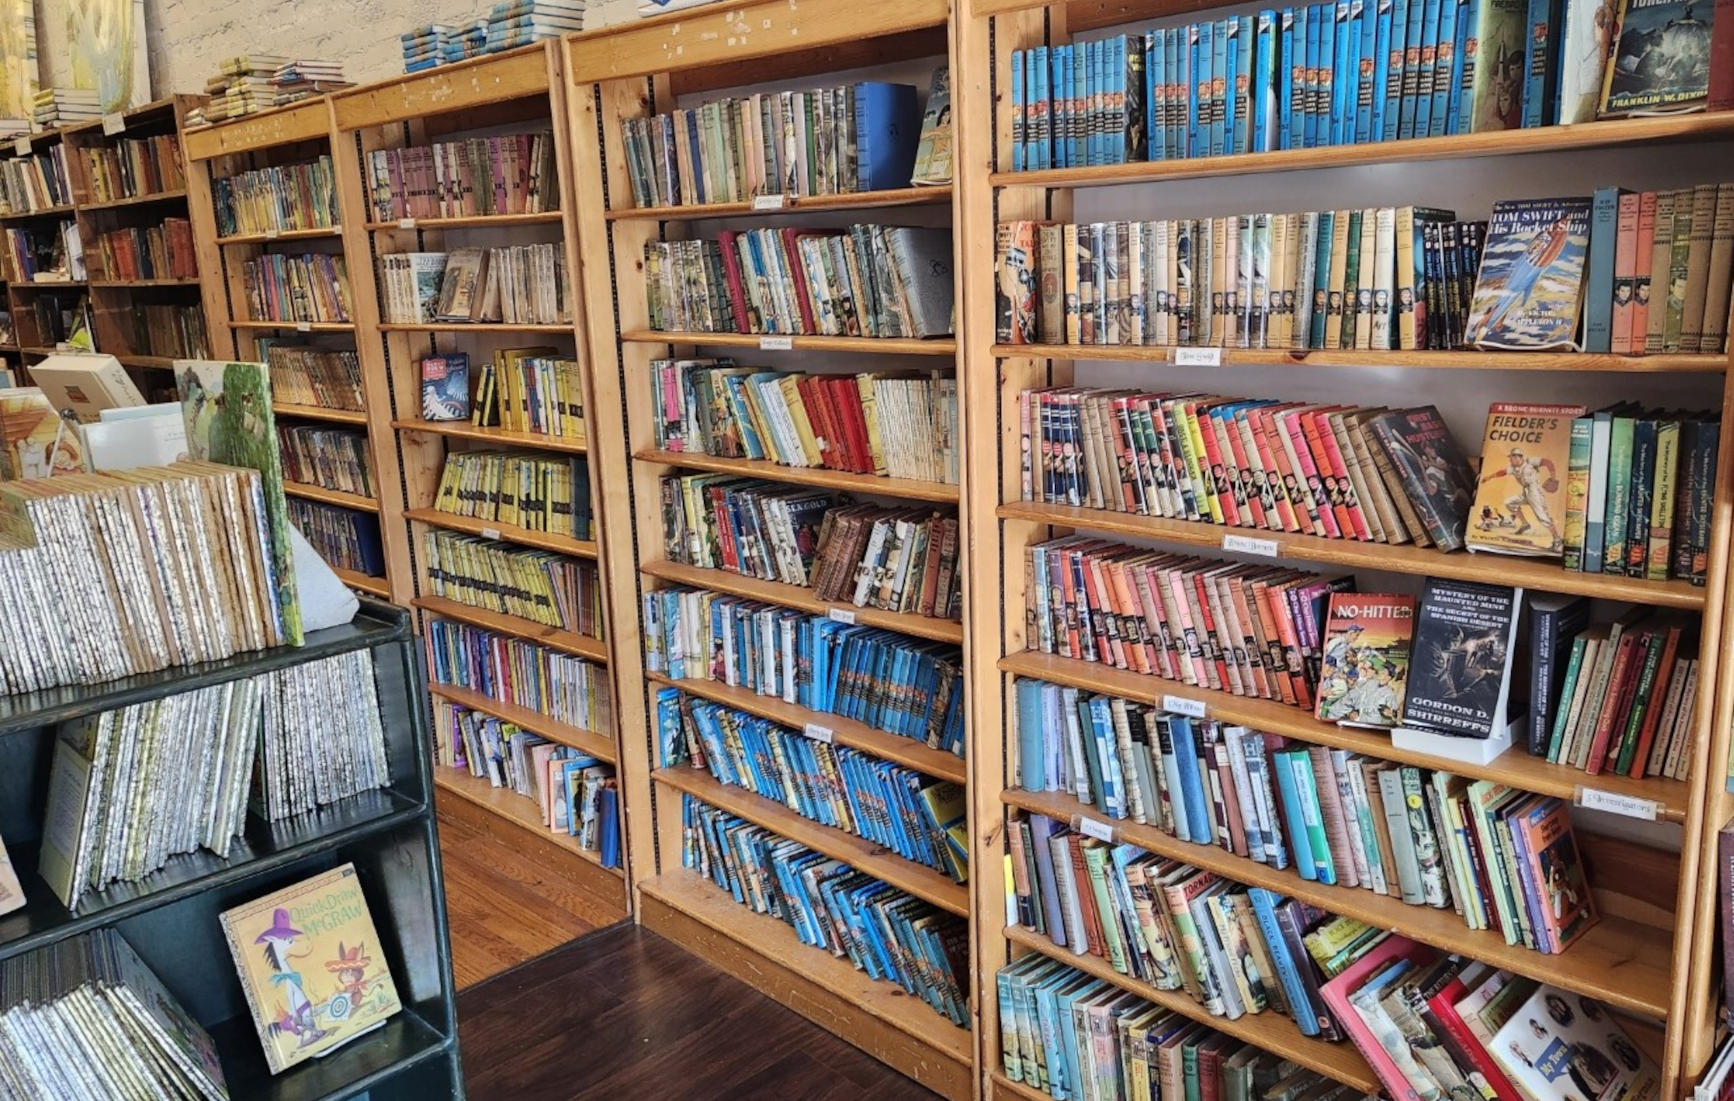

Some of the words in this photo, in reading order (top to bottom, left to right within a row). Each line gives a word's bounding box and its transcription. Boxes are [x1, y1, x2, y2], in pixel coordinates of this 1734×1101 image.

[1612, 95, 1660, 108] FRANKLIN
[1664, 93, 1676, 102] W.
[1493, 211, 1519, 223] TOM
[1521, 209, 1564, 221] SWIFT
[1567, 209, 1590, 219] and
[1490, 223, 1509, 235] His
[1511, 221, 1554, 233] Rocket
[1558, 219, 1587, 235] Ship
[1492, 416, 1558, 430] FIELDER'S
[1490, 430, 1543, 443] CHOICE
[786, 503, 803, 513] SEA
[804, 500, 827, 510] GOLD
[1431, 588, 1475, 600] MYSTERY
[1490, 597, 1509, 605] THE
[1337, 604, 1410, 618] NO-HITTER
[1480, 602, 1505, 610] MINE
[1412, 697, 1473, 716] GORDON
[1476, 710, 1489, 719] D.
[1407, 709, 1490, 733] SHIRREFFS
[291, 899, 326, 923] Quick
[326, 886, 359, 910] Draw
[303, 900, 363, 940] McGRAW
[1260, 914, 1275, 940] BLACK
